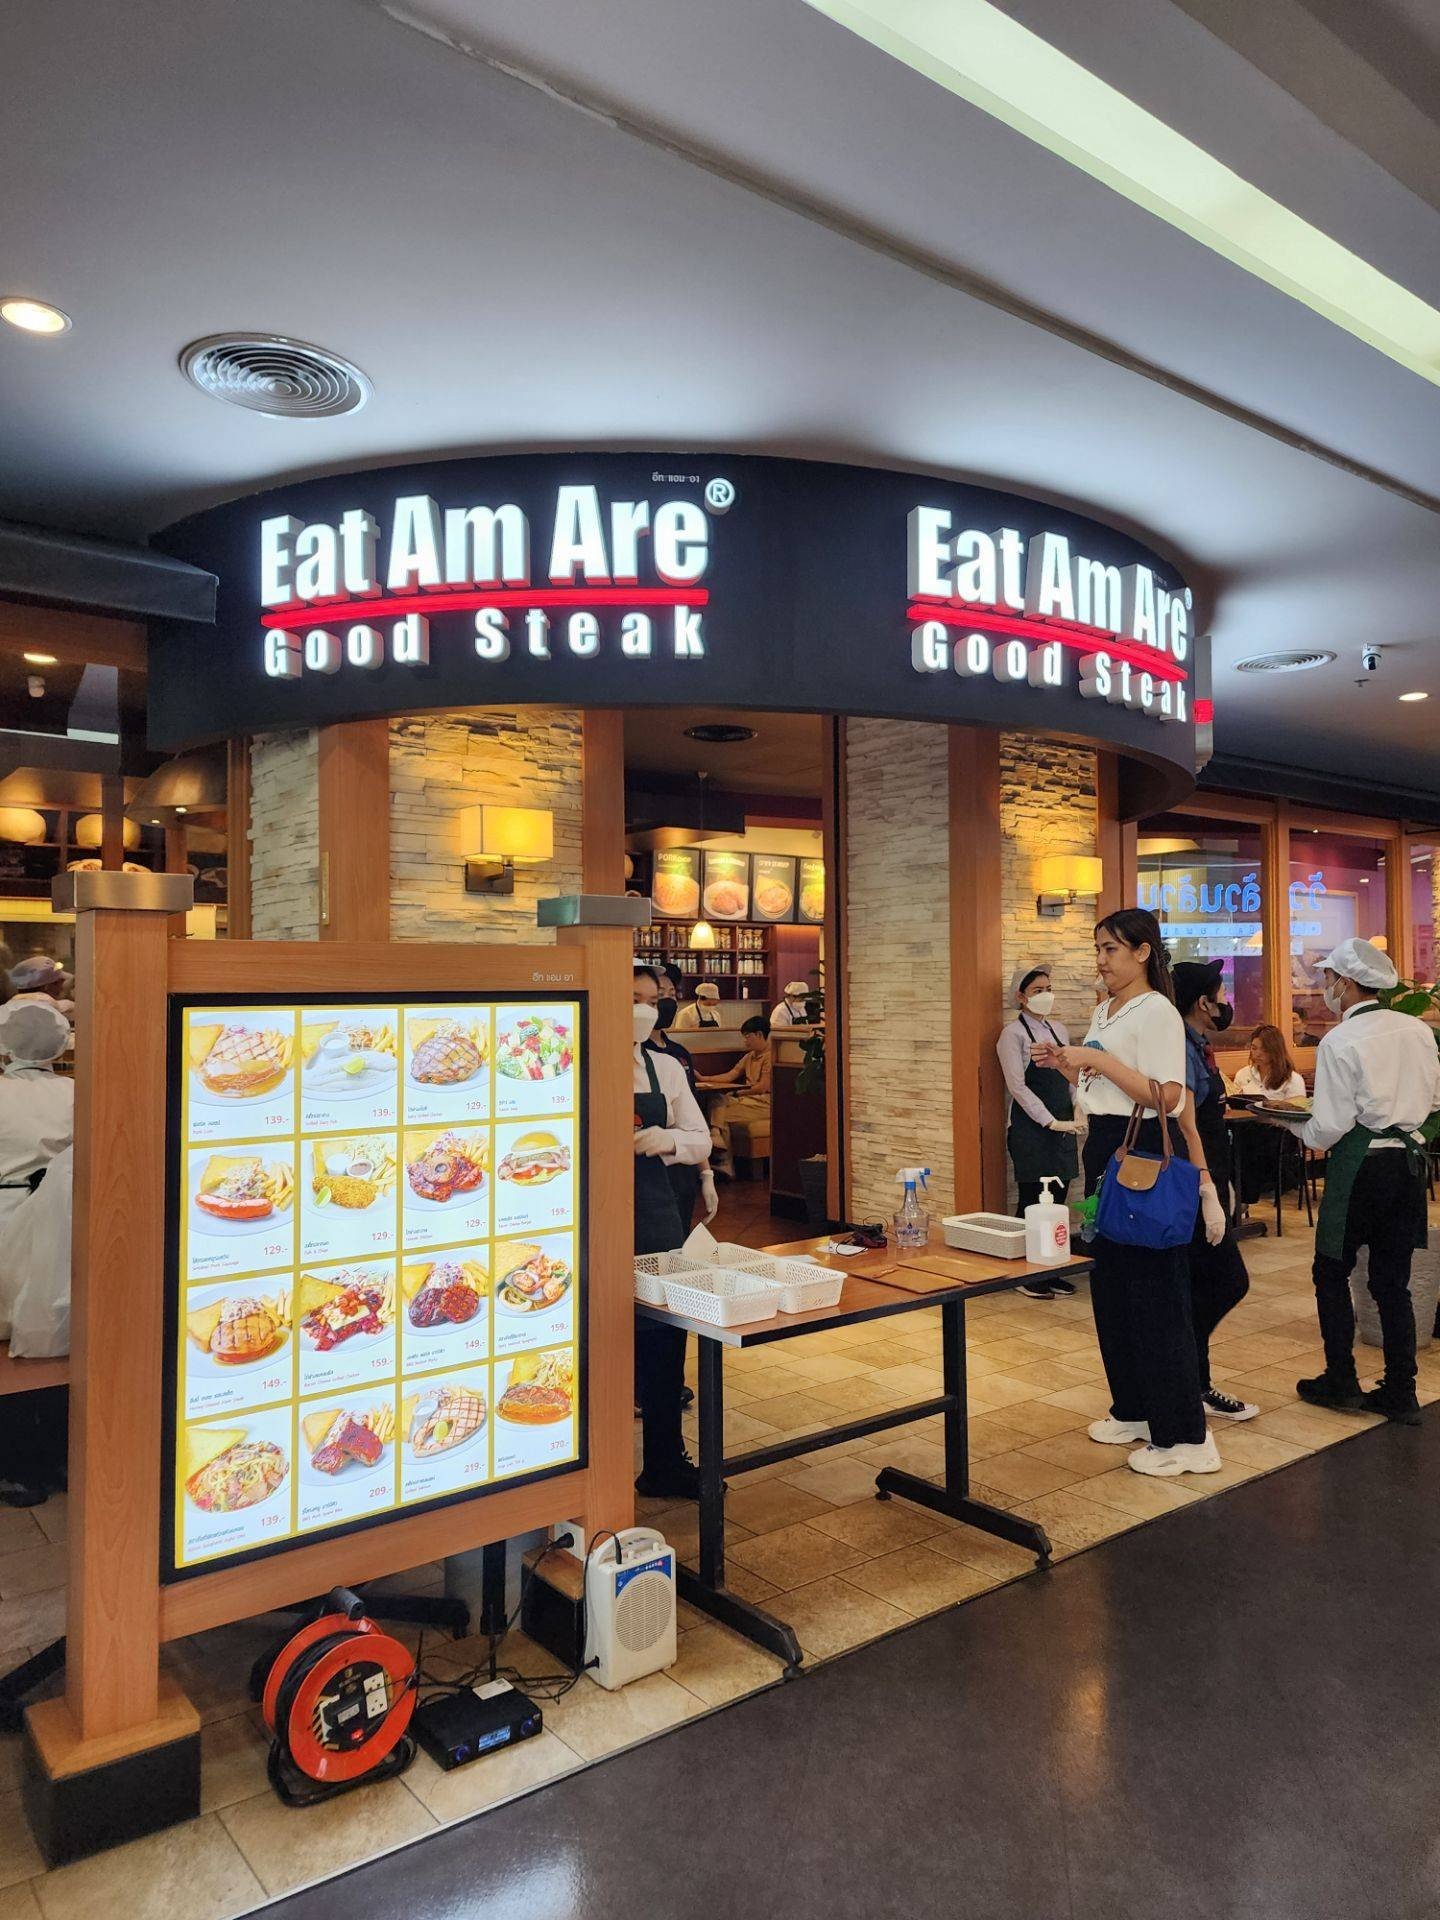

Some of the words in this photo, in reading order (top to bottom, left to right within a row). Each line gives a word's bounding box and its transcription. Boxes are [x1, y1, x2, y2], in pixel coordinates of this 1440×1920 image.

[260, 508, 379, 608] Eat
[387, 494, 530, 590] Am
[548, 484, 709, 585] Are
[908, 505, 1025, 612] Eat
[1025, 531, 1122, 633] Am
[1120, 563, 1188, 661] Are
[264, 613, 430, 679] Good
[474, 604, 704, 660] Steak
[911, 620, 1064, 688] Good
[1079, 651, 1187, 722] Steak
